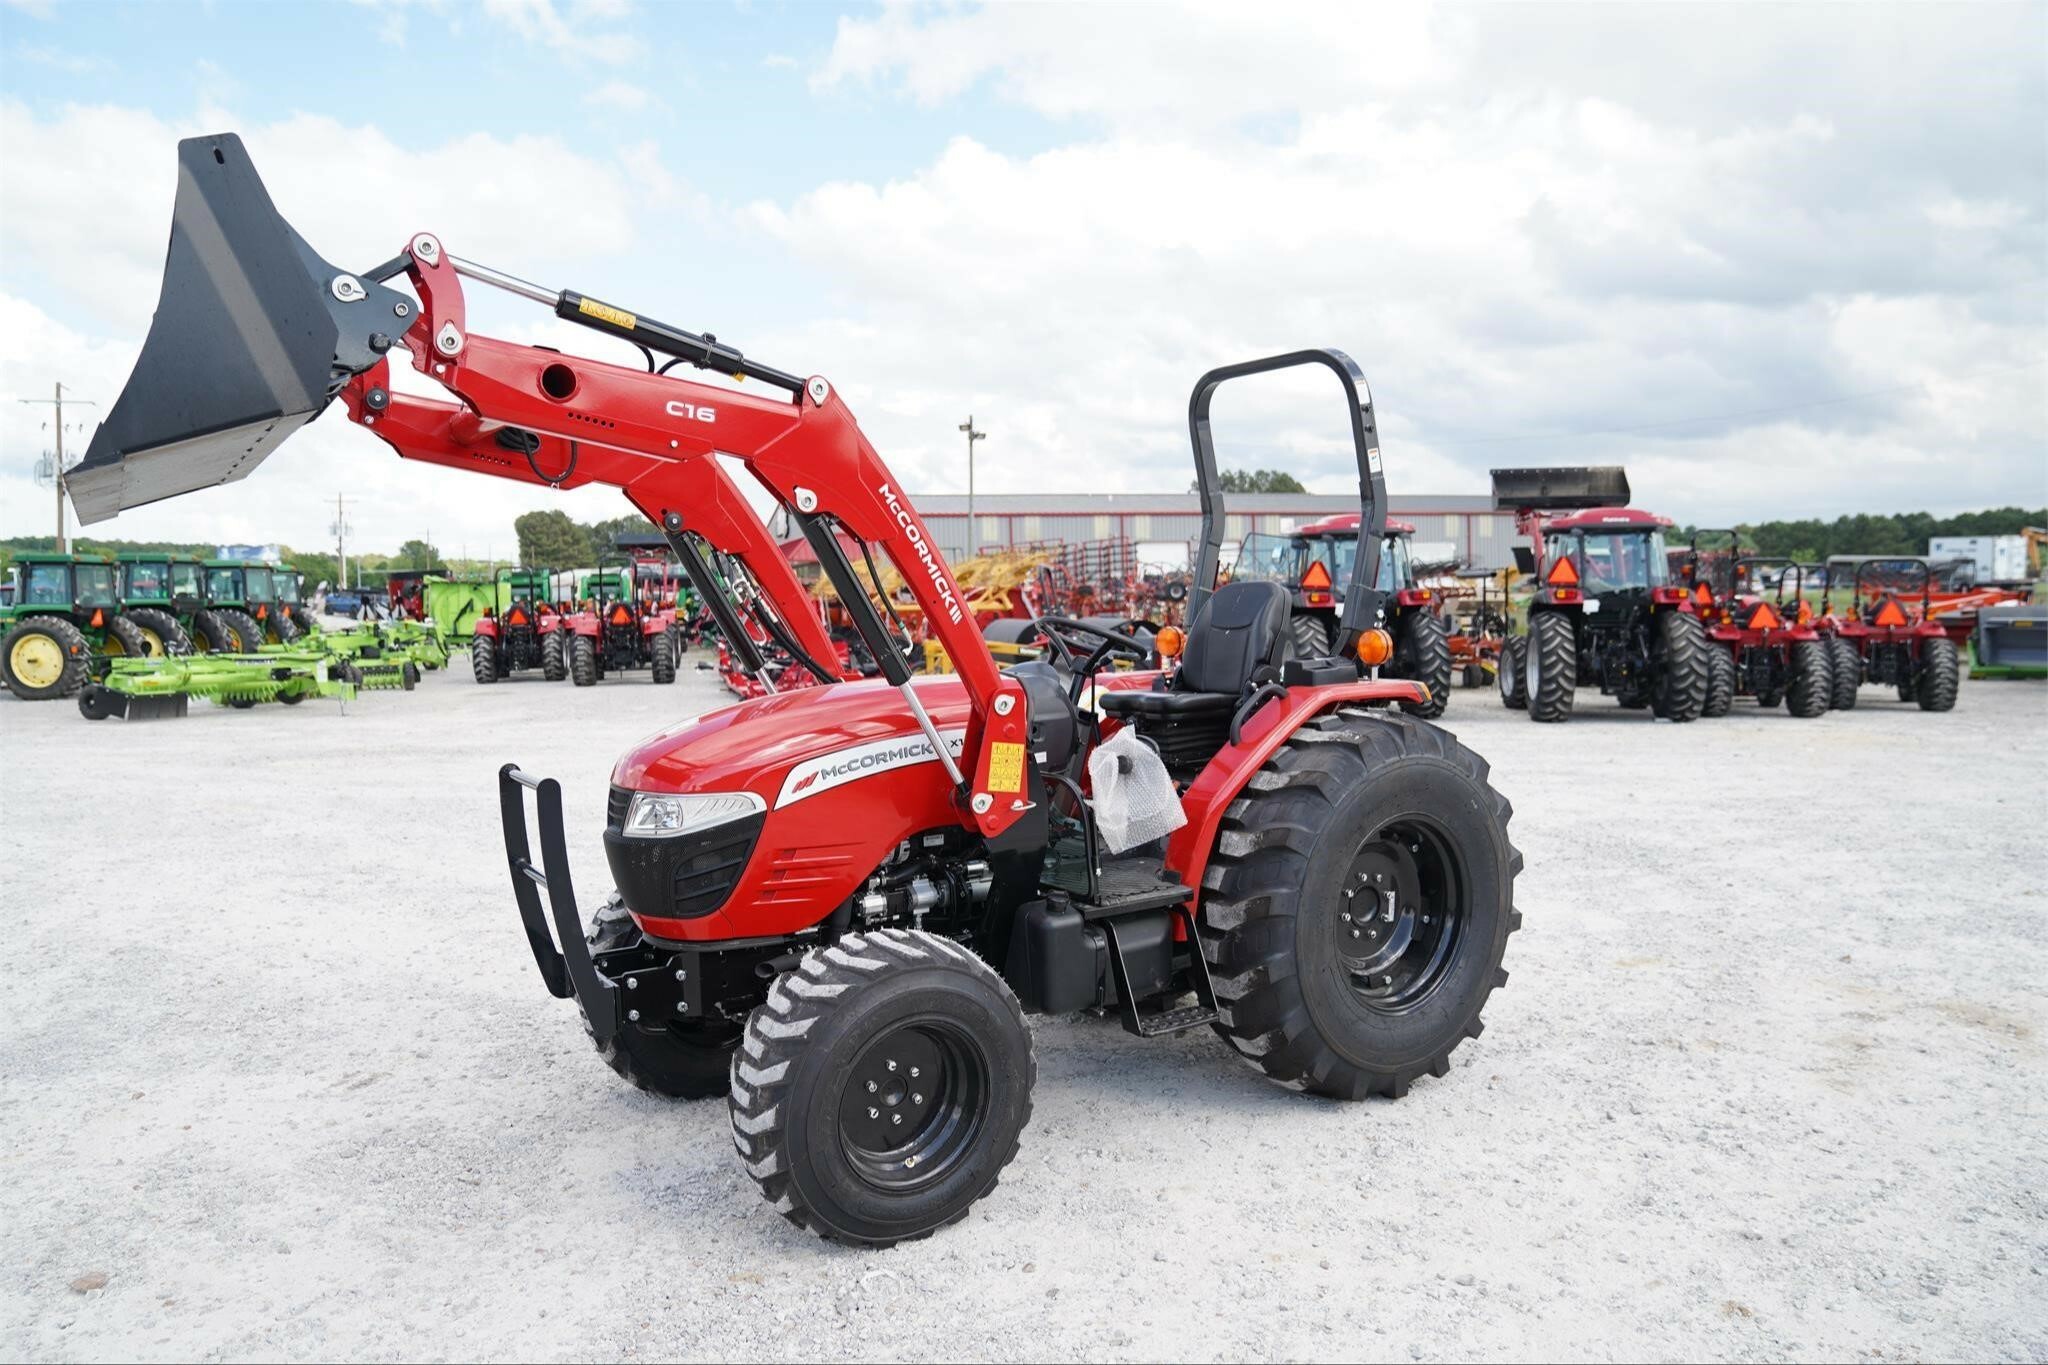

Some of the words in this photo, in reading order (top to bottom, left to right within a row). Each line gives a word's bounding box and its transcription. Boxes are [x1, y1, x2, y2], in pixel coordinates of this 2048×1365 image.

[666, 400, 716, 423] C16
[878, 483, 957, 609] McCORMICK
[820, 743, 934, 781] McCORMICK
